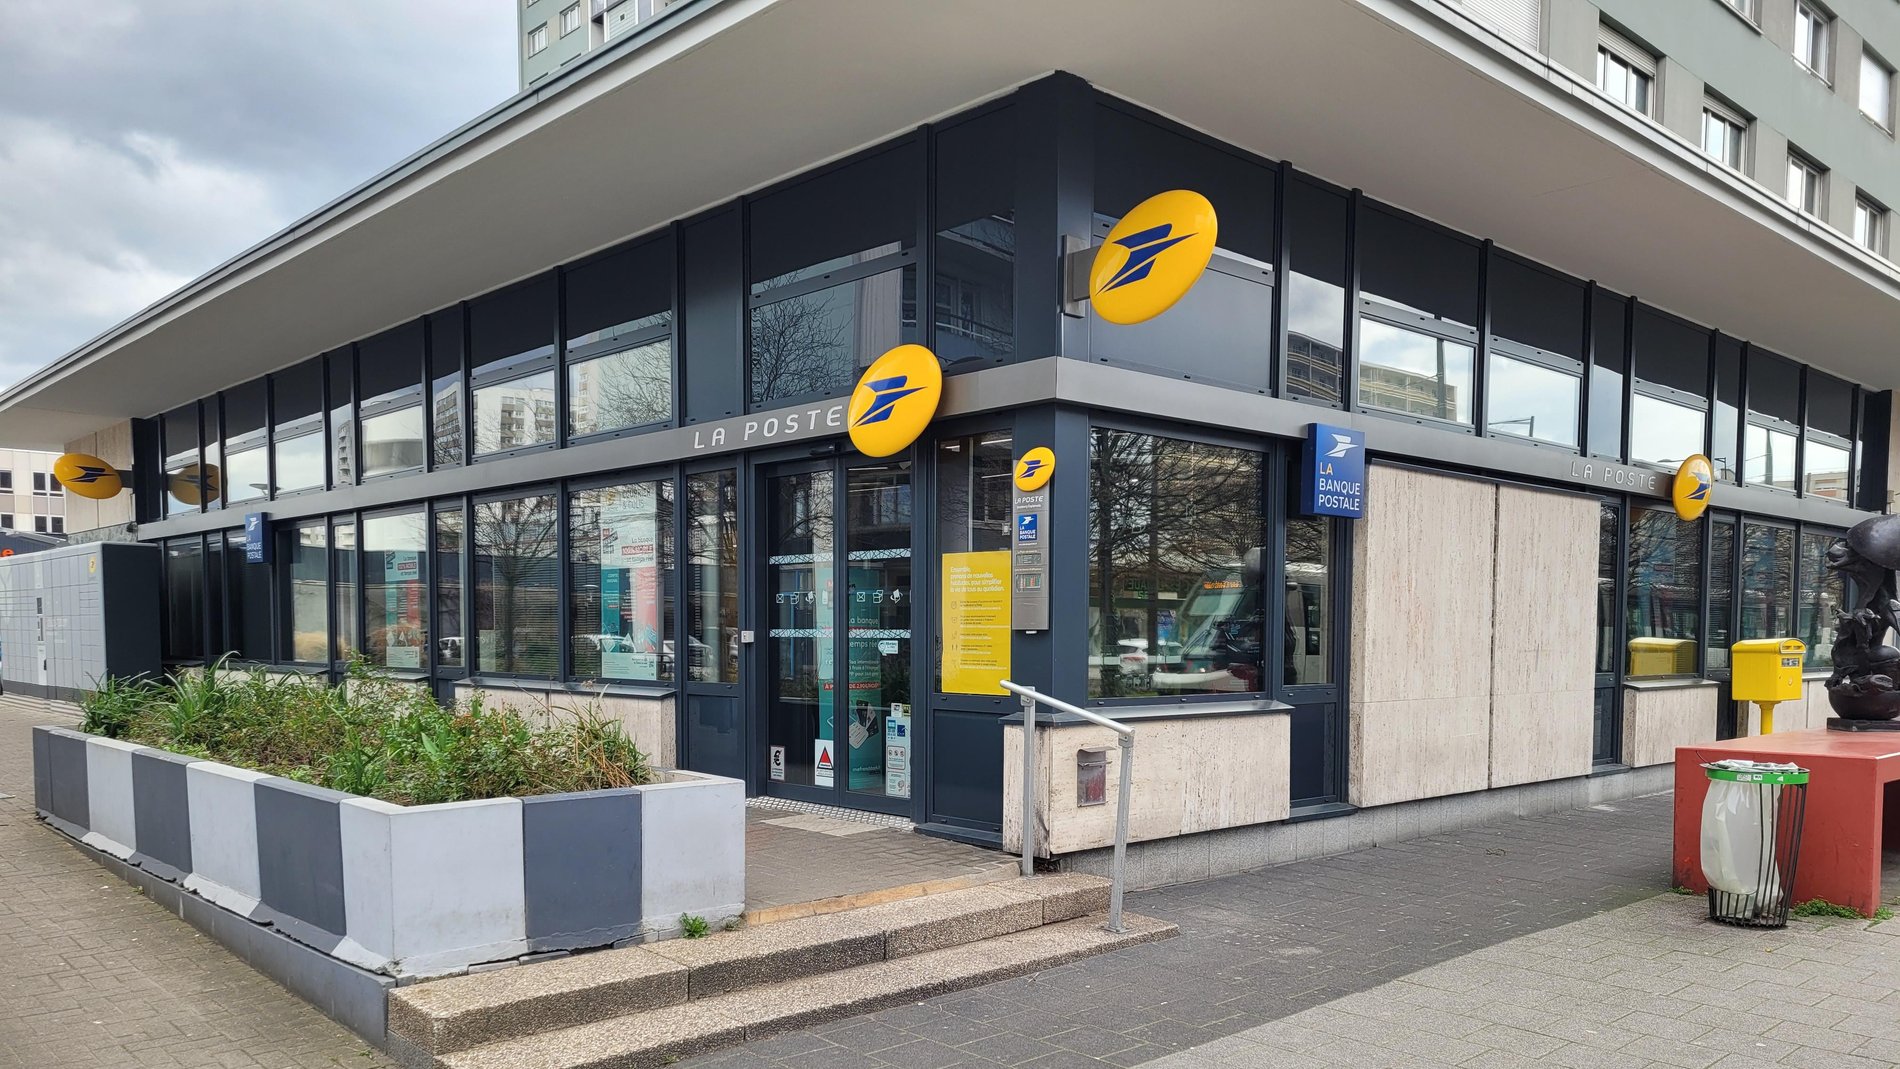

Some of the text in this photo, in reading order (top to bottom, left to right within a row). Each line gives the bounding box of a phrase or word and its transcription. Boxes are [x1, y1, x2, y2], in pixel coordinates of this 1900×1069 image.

[693, 405, 843, 449] LA POSTE
[1319, 462, 1333, 475] LA
[1570, 461, 1657, 490] LA POSTE
[1319, 478, 1360, 495] BANQUE
[1022, 495, 1044, 503] POSTE
[1318, 494, 1360, 511] POSTALE
[849, 641, 868, 649] emps
